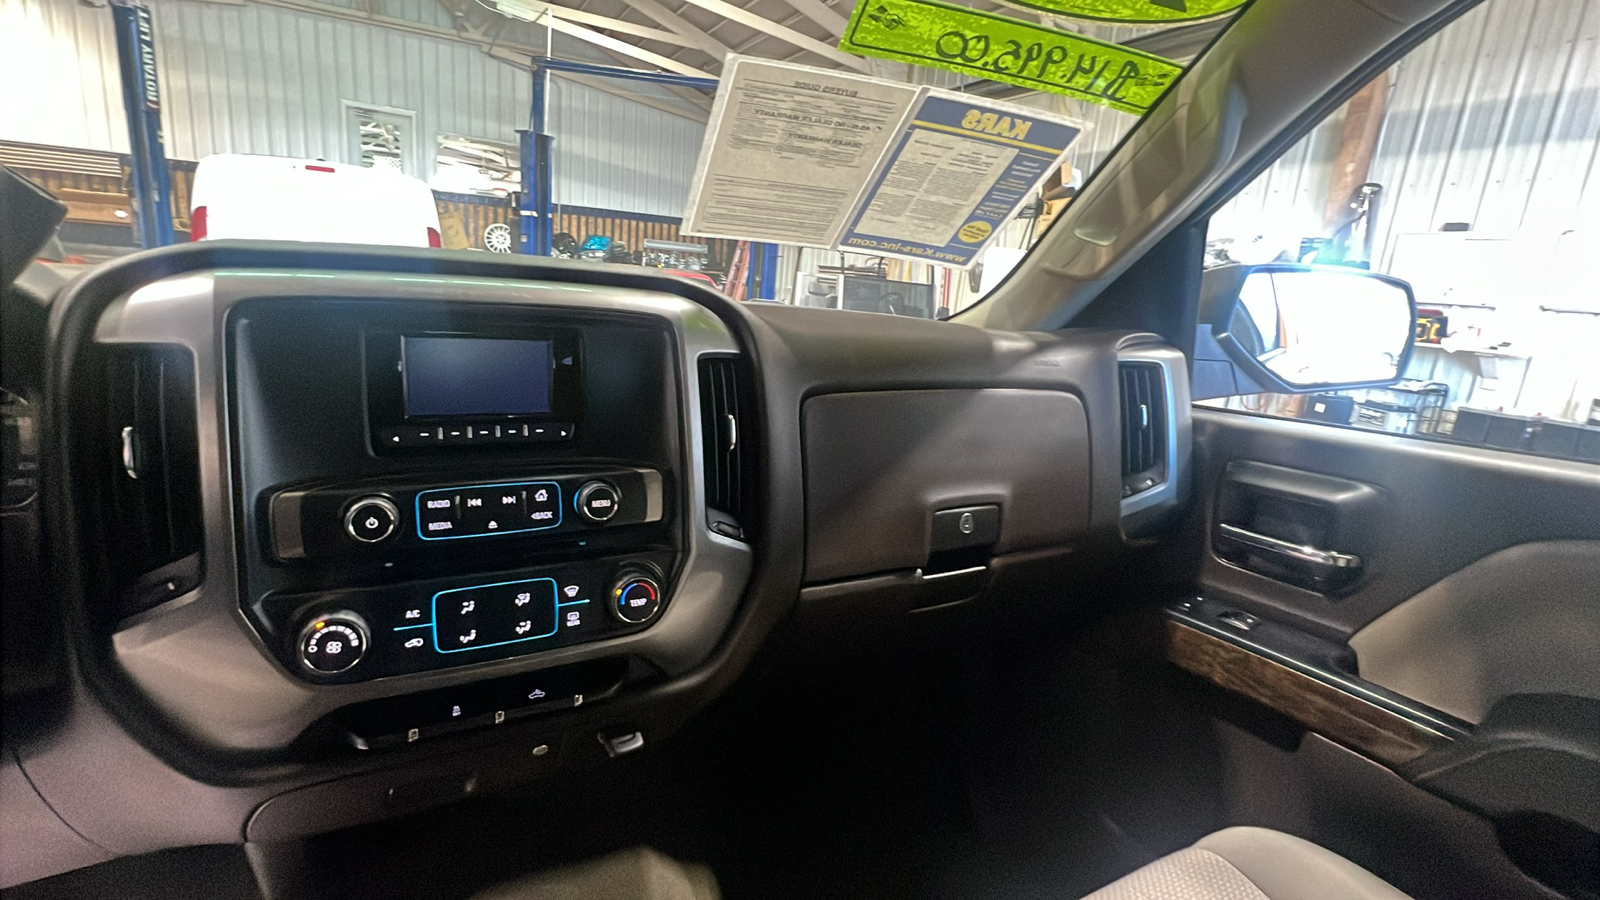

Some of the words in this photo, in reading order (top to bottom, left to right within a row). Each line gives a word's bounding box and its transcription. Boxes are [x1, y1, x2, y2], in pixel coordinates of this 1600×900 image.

[137, 9, 151, 41] LIFT
[141, 43, 158, 101] ROTARY
[427, 499, 450, 509] RADIO
[591, 499, 611, 508] MENU
[428, 521, 452, 531] MEDIA
[629, 598, 647, 607] TEMP
[405, 609, 421, 619] A/C
